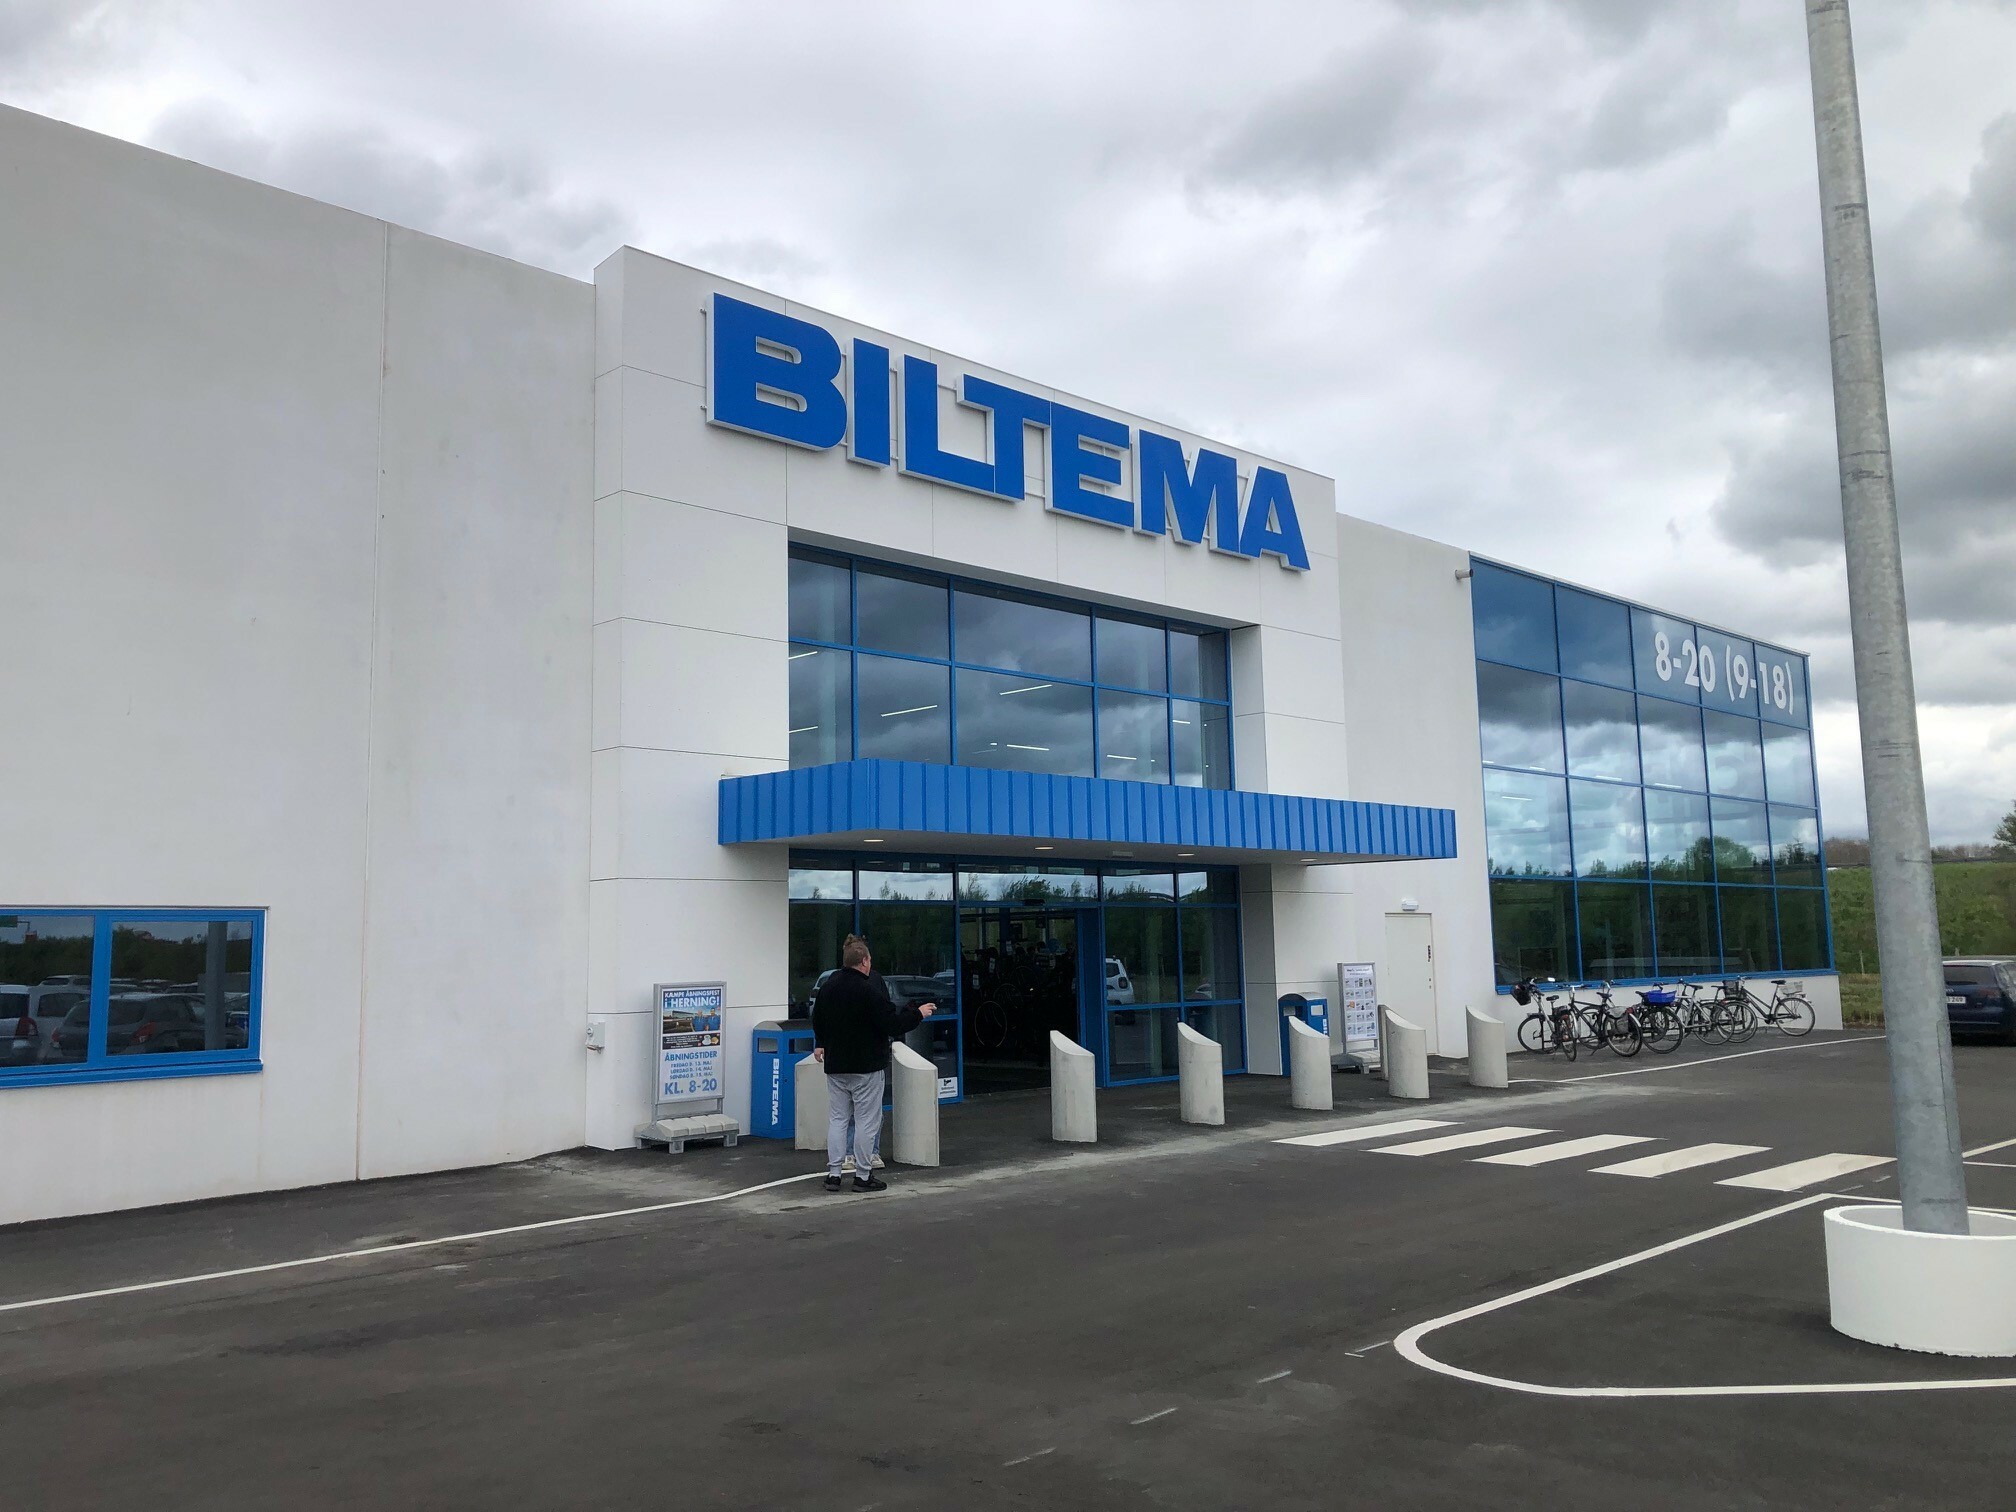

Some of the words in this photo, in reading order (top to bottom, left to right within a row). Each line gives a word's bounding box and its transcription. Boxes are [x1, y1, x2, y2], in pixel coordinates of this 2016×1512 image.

[710, 291, 1311, 571] BILTEMA
[1654, 631, 1716, 693] 8-20
[1725, 644, 1794, 715] (9-18)
[665, 1050, 718, 1061] ÅBNINGSTIDER
[665, 1082, 684, 1095] KL.
[689, 1078, 718, 1093] 8-20
[771, 1058, 780, 1126] BILTEMA
